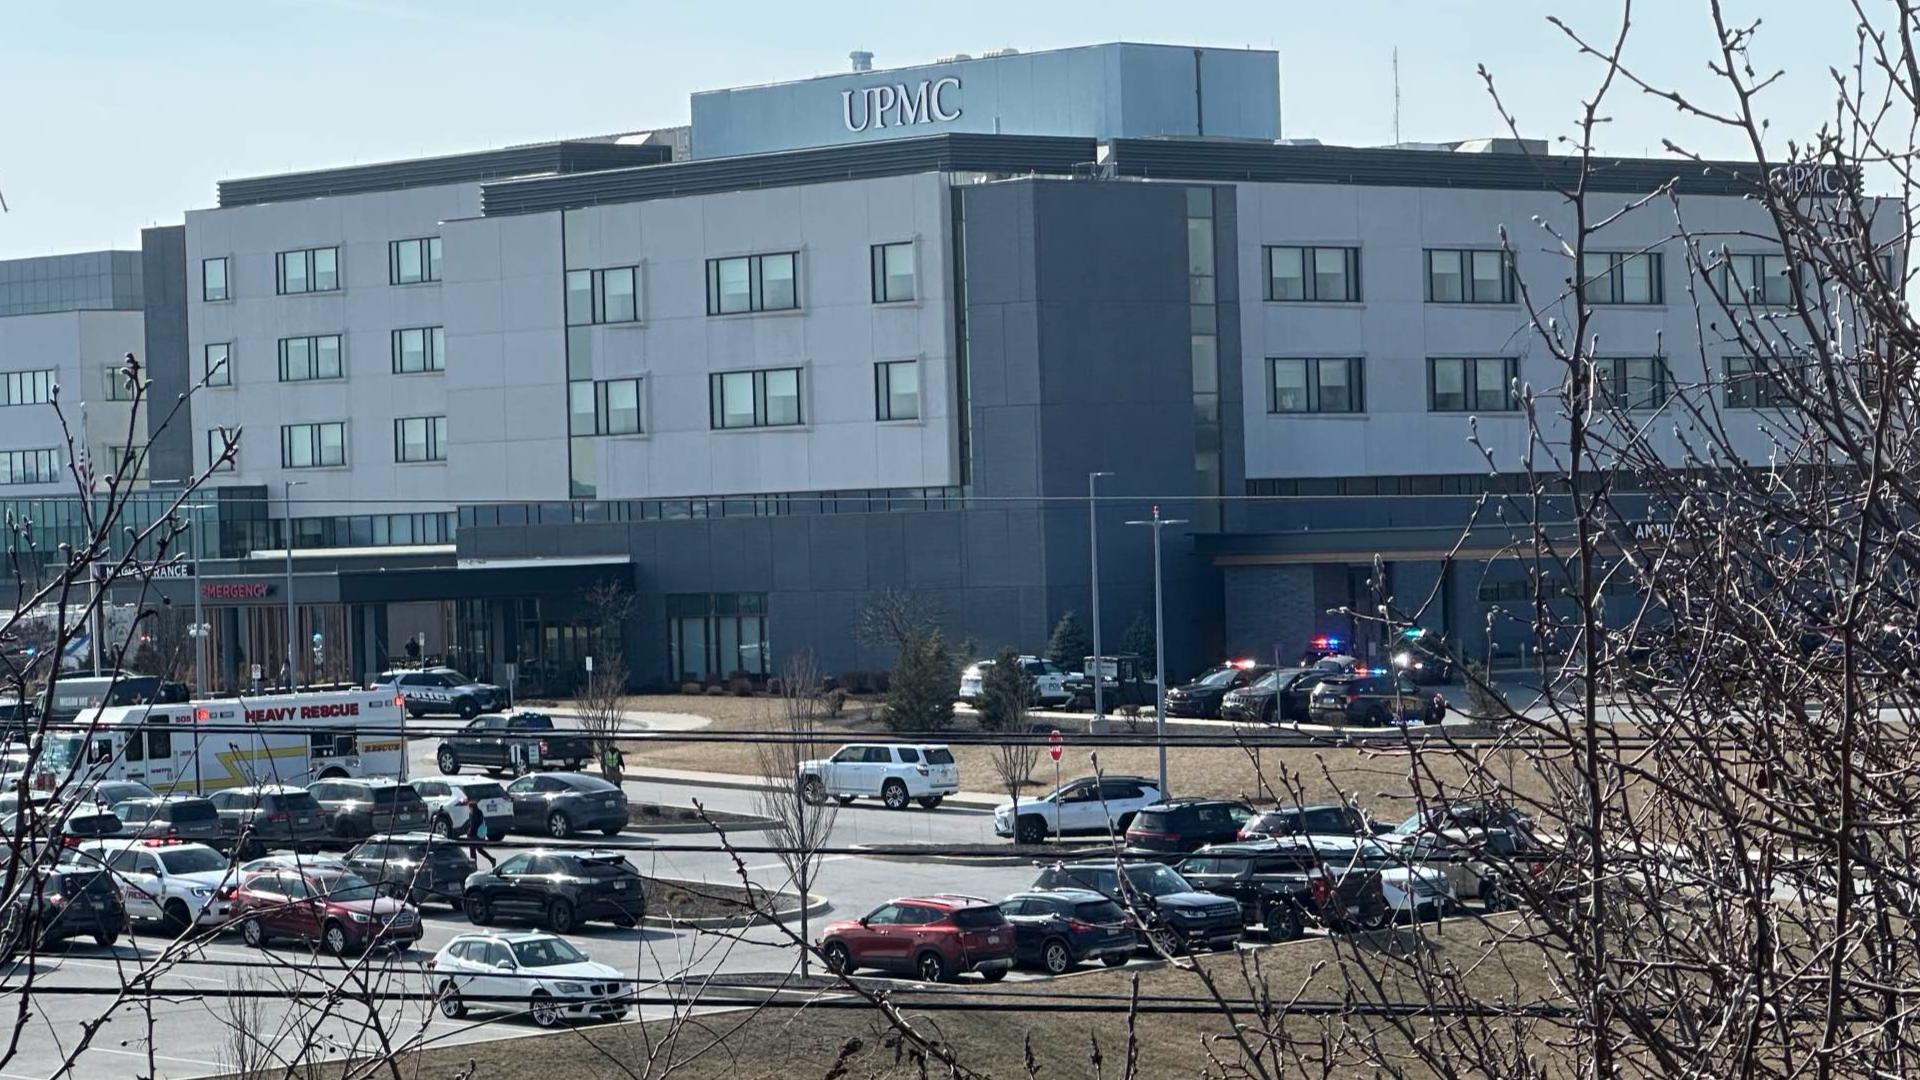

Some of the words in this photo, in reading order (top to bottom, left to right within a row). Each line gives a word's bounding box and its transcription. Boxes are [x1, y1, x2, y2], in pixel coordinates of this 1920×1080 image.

[841, 78, 961, 132] UPMC
[1781, 165, 1839, 193] PMC
[201, 584, 268, 598] EMERGENCY
[244, 706, 296, 723] HEAVY
[300, 703, 359, 719] RESCUE
